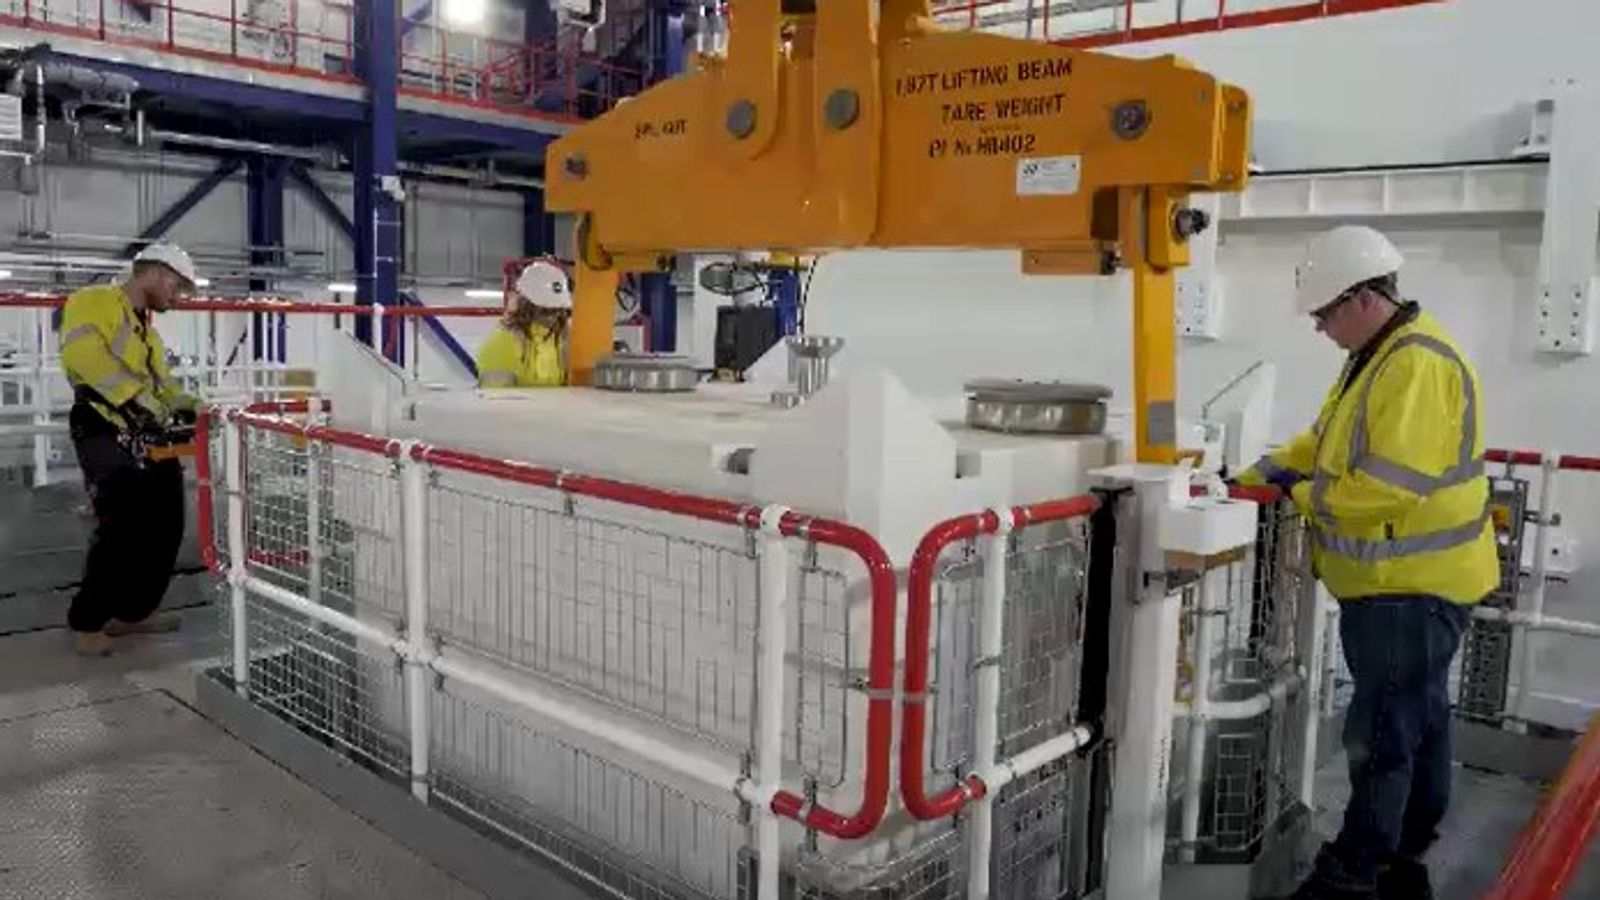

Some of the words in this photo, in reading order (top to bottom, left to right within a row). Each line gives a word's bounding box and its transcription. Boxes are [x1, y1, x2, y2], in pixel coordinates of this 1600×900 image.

[942, 65, 1008, 91] LIFTING
[1018, 58, 1073, 80] BEAM
[942, 102, 986, 124] TARE
[995, 93, 1065, 118] WEIGHT
